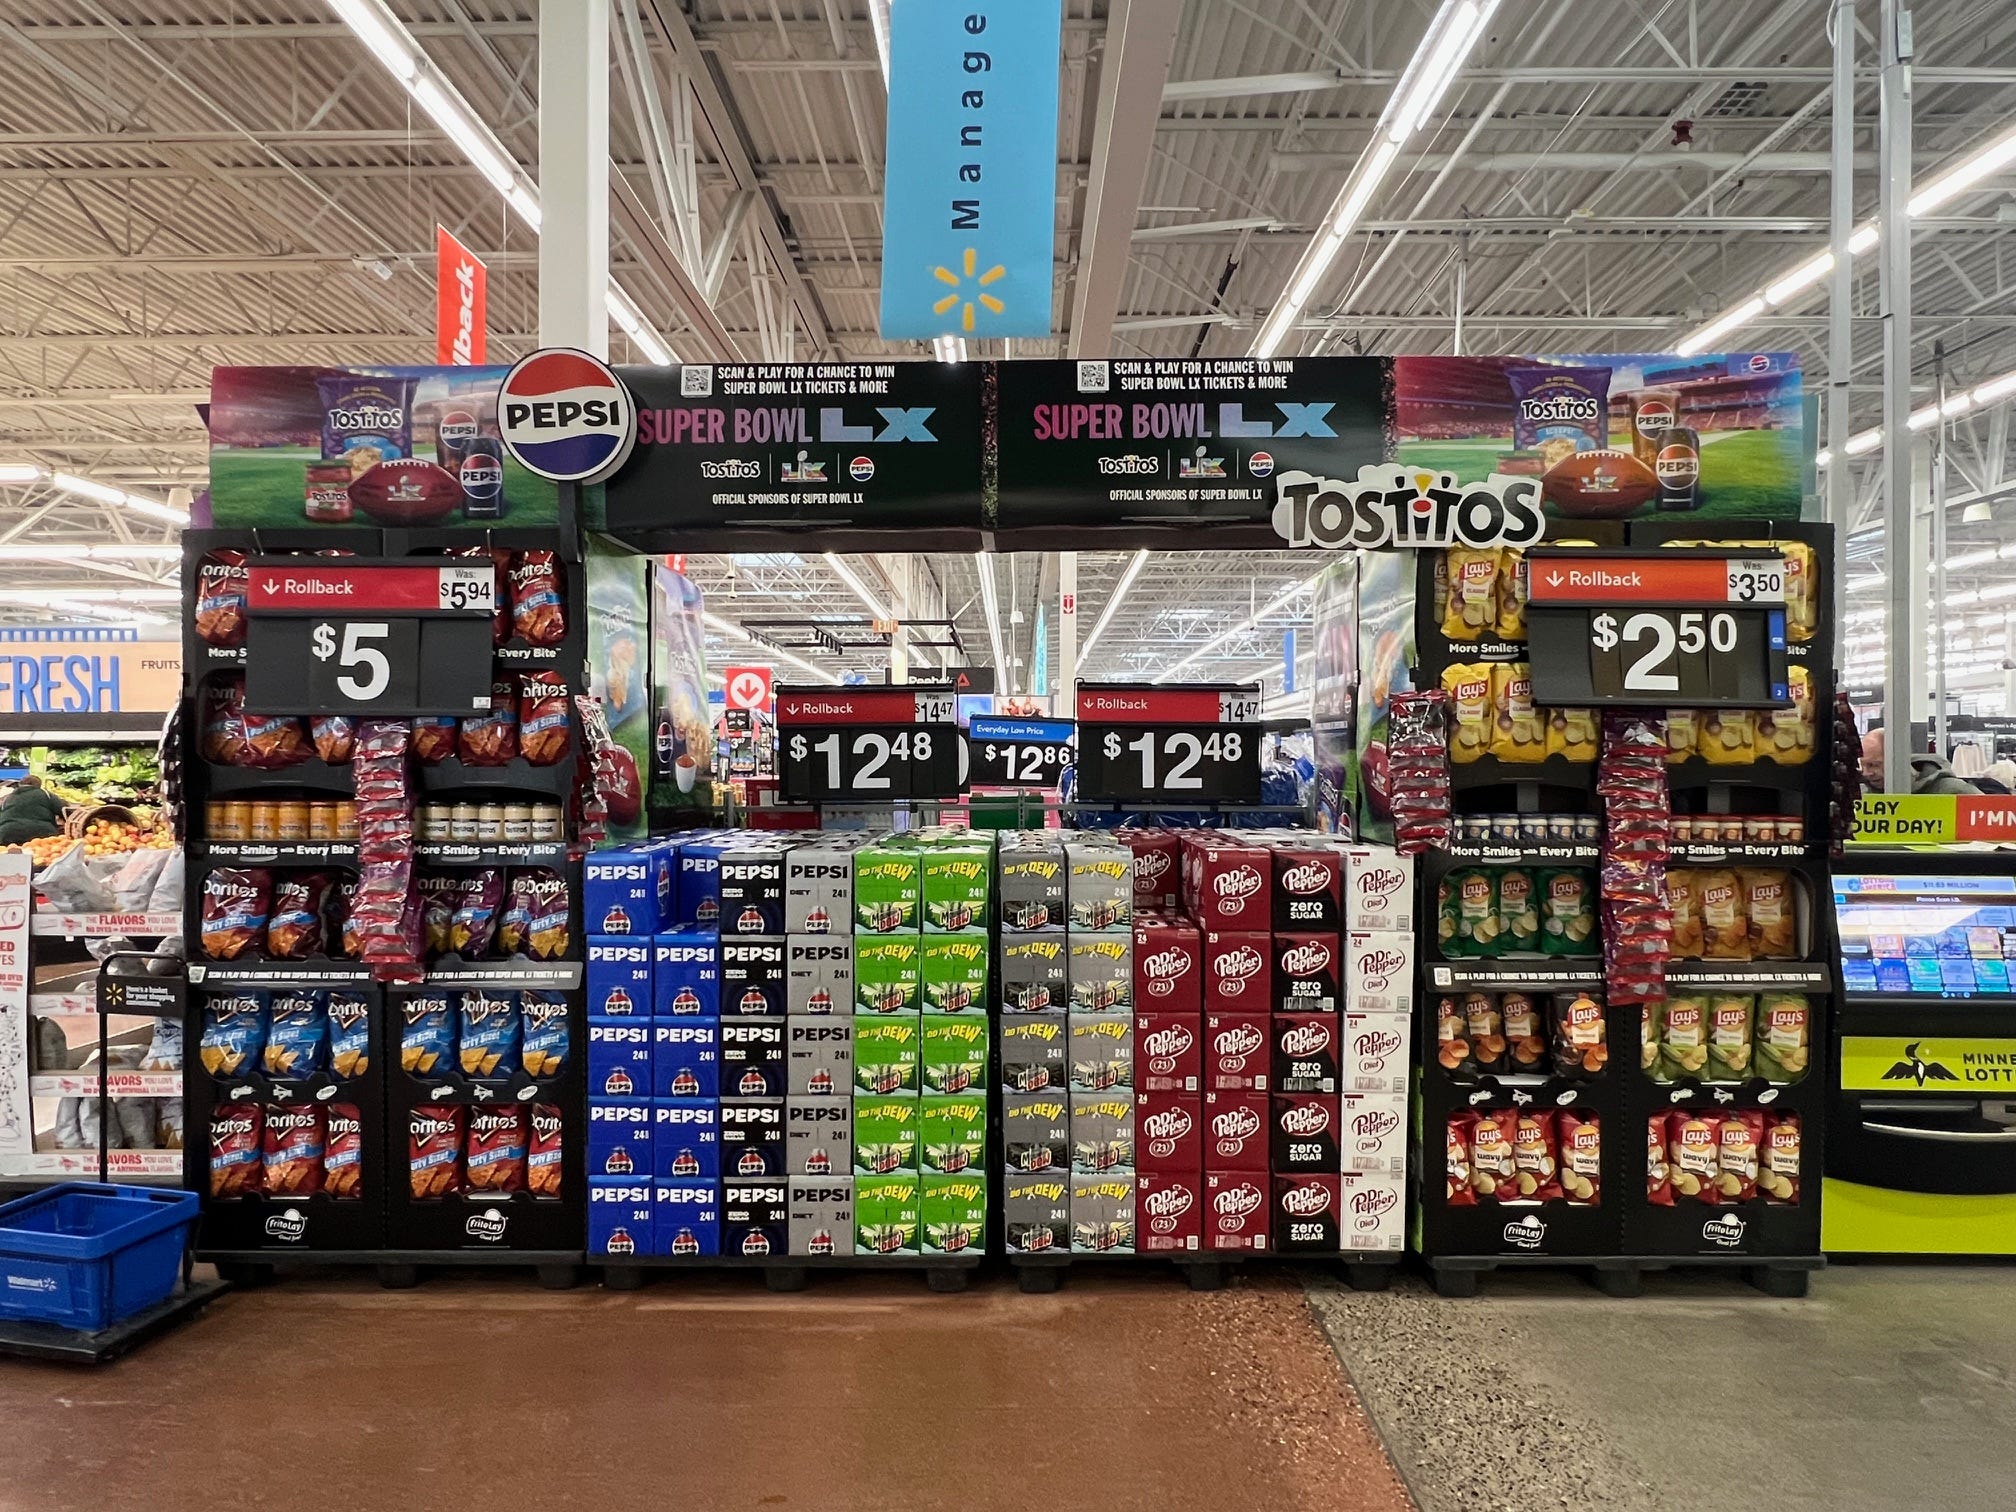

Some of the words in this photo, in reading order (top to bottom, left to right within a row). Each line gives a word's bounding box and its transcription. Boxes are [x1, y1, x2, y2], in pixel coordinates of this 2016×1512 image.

[951, 14, 992, 230] Manage
[452, 258, 474, 366] lback
[718, 366, 744, 378] SCAN
[747, 366, 755, 378] &
[758, 366, 782, 378] PLAY
[785, 366, 804, 378] FOR
[807, 366, 814, 378] A
[817, 366, 856, 378] CHANCE
[859, 366, 871, 378] TO
[875, 366, 895, 378] WIN
[1114, 361, 1141, 374] SCAN
[1144, 361, 1152, 374] &
[1155, 361, 1180, 374] PLAY
[1182, 361, 1201, 374] FOR
[1204, 361, 1212, 374] A
[1214, 361, 1255, 374] CHANCE
[1257, 361, 1270, 374] TO
[1273, 361, 1294, 374] WIN
[724, 381, 756, 394] SUPER
[759, 381, 787, 394] BOWL
[791, 381, 802, 394] LX
[805, 381, 846, 394] TICKETS
[849, 381, 857, 394] &
[859, 381, 888, 394] MORE
[1121, 377, 1153, 389] SUPER
[1157, 377, 1185, 389] BOWL
[1189, 377, 1200, 389] LX
[1203, 377, 1245, 389] TICKETS
[1247, 377, 1255, 389] &
[1258, 377, 1288, 389] MORE
[507, 400, 621, 430] PEPSI
[1033, 403, 1123, 440] SUPER
[1133, 403, 1212, 438] BOWL
[1219, 403, 1339, 437] LX
[1638, 417, 1672, 425] PEPSI
[442, 427, 476, 435] PEPSI
[638, 408, 726, 445] SUPER
[734, 408, 813, 443] BOWL
[820, 407, 939, 442] LX
[1658, 462, 1697, 472] PEPSI
[463, 472, 501, 482] PEPSI
[712, 493, 746, 504] OFFICIAL
[748, 493, 789, 504] SPONSORS
[791, 493, 801, 504] OF
[803, 493, 828, 504] SUPER
[829, 493, 851, 504] BOWL
[854, 493, 864, 504] LX
[1110, 489, 1143, 500] OFFICIAL
[1145, 489, 1187, 500] SPONSORS
[1188, 489, 1199, 500] OF
[1200, 489, 1226, 500] SUPER
[1228, 489, 1250, 500] BOWL
[1252, 489, 1262, 500] LX
[200, 565, 248, 579] oritos
[1464, 561, 1492, 578] Lay's
[1569, 570, 1641, 588] Rollback
[284, 579, 353, 595] Rollback
[208, 648, 237, 657] More
[498, 649, 531, 660] Every
[1450, 644, 1478, 653] More
[1481, 643, 1519, 653] Smiles
[142, 660, 181, 669] FRUITS
[312, 622, 390, 700] $5
[1458, 681, 1486, 700] Lay's
[803, 703, 853, 714] Rollback
[1097, 698, 1148, 710] Rollback
[976, 724, 1009, 736] Everyday
[1010, 726, 1025, 734] Low
[1026, 727, 1044, 735] Price
[1852, 820, 1889, 833] OUR
[1896, 820, 1943, 834] DAY!
[209, 845, 238, 855] More
[240, 845, 278, 855] Smiles
[296, 845, 329, 856] Every
[442, 845, 480, 855] Smiles
[499, 845, 530, 856] Every
[1451, 847, 1480, 856] More
[1483, 846, 1521, 856] Smiles
[1540, 847, 1572, 858] Every
[1576, 846, 1598, 856] Bite
[1688, 845, 1726, 855] Smiles
[1745, 845, 1778, 857] Every
[587, 866, 646, 880] PEPSI
[722, 865, 780, 880] PEPSI
[791, 865, 848, 879] PEPSI
[884, 863, 914, 882] DEW
[1028, 861, 1058, 880] DEW
[1219, 873, 1258, 896] Pepper
[1288, 870, 1327, 892] Pepper
[1362, 873, 1402, 893] Pepper
[1290, 902, 1323, 912] zero
[99, 915, 145, 925] FLAVORS
[589, 947, 647, 962] PEPSI
[792, 946, 849, 960] PEPSI
[1670, 1009, 1698, 1025] Lay's
[1717, 1009, 1745, 1025] Lay's
[1963, 1053, 2016, 1065] MINNE
[1965, 1069, 2016, 1081] LOTT
[410, 1119, 455, 1134] oritos
[1682, 1129, 1712, 1145] Lay's
[1477, 1153, 1500, 1162] wavy
[1683, 1153, 1708, 1164] wavy
